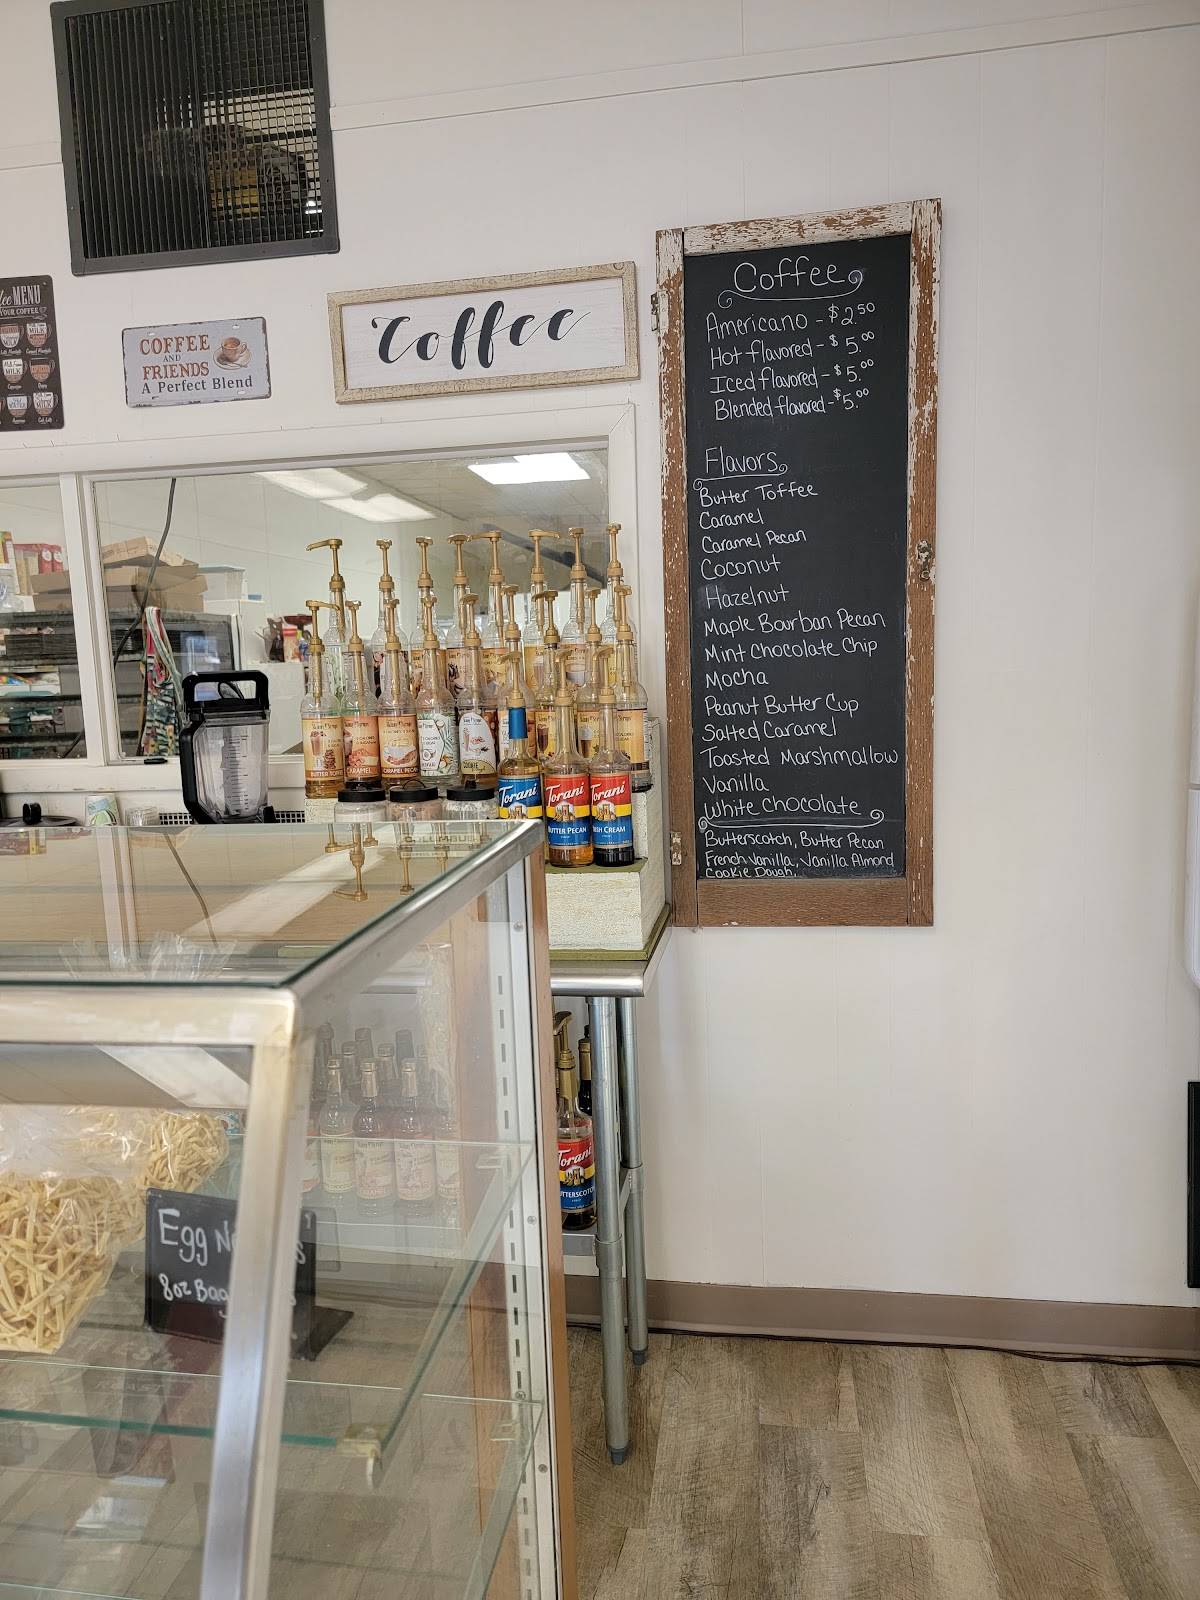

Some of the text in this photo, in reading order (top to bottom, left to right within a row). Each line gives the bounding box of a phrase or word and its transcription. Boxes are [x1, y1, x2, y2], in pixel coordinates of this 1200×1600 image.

[734, 255, 845, 293] Coffee
[12, 284, 41, 306] MENU
[16, 307, 40, 316] COFFEE
[371, 300, 591, 370] Coffee
[706, 311, 808, 343] Americano
[140, 334, 210, 355] COFFEE
[710, 345, 742, 370] Hot
[745, 338, 813, 364] flavored
[163, 354, 181, 362] AND
[142, 361, 210, 381] FRIENDS
[710, 371, 756, 394] Iced
[758, 367, 818, 390] flavored
[142, 375, 253, 394] A Perfect Blend
[715, 398, 773, 421] Blended
[774, 395, 825, 417] flavored
[705, 446, 778, 475] Flavors
[700, 481, 818, 507] Butter Toffee
[700, 508, 764, 530] Caramel
[702, 529, 807, 554] Caramel Pecan
[700, 554, 782, 580] Coconut
[706, 583, 790, 610] Hazelnut
[704, 615, 755, 638] Maple
[836, 608, 886, 630] Pecan
[704, 643, 746, 663] Mint
[842, 637, 878, 657] Chip
[705, 668, 769, 691] Mocha
[704, 693, 859, 718] Peanut Butter Cup
[702, 717, 837, 742] Salted Caramel
[700, 745, 899, 769] Toasted Marshmallow
[346, 767, 372, 775] CARAMEL
[499, 783, 537, 807] Torani
[546, 782, 584, 807] Torani
[591, 781, 625, 805] Torani
[703, 773, 769, 794] Vanilla
[704, 798, 760, 820] White
[568, 826, 587, 834] PECAN
[604, 825, 626, 833] CREAM
[800, 831, 843, 849] Butter
[847, 832, 884, 849] Pecan
[704, 850, 746, 867] French
[800, 852, 849, 868] Vanilla
[851, 852, 894, 867] Almond
[705, 867, 749, 879] Cookie
[158, 1208, 208, 1266] Egg
[159, 1272, 192, 1301] 8oz
